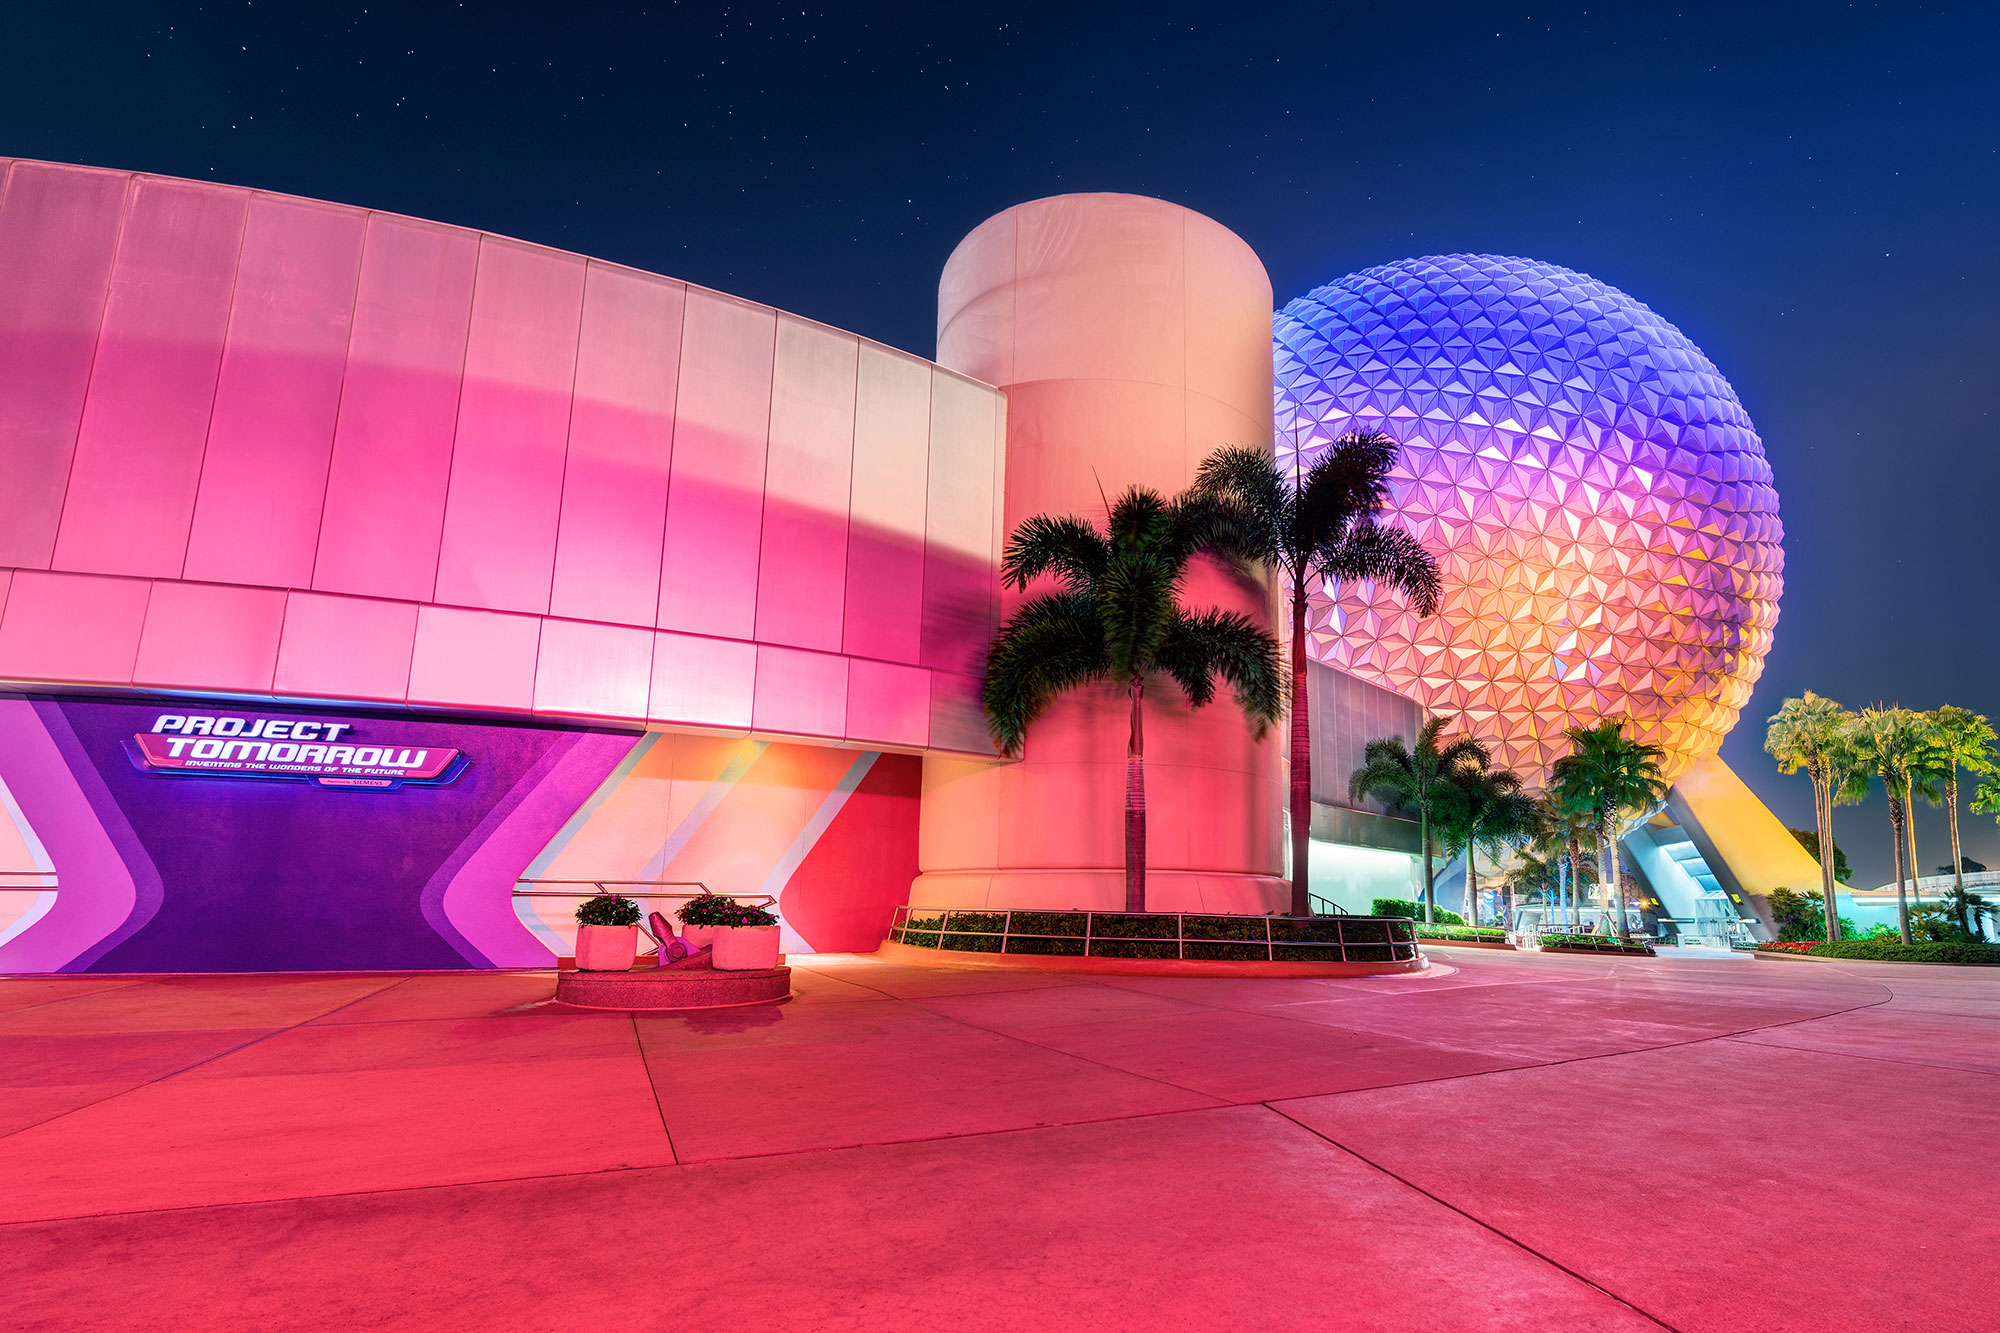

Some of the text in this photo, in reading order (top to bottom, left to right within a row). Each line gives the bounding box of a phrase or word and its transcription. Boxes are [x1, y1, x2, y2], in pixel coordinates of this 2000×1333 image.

[151, 714, 351, 742] PROJECT
[166, 737, 428, 768] TOMORROW
[185, 760, 242, 769] INVENTING
[245, 762, 267, 770] THE
[269, 763, 321, 772] WONDERS
[342, 766, 362, 774] THE
[364, 767, 404, 775] FUTURE
